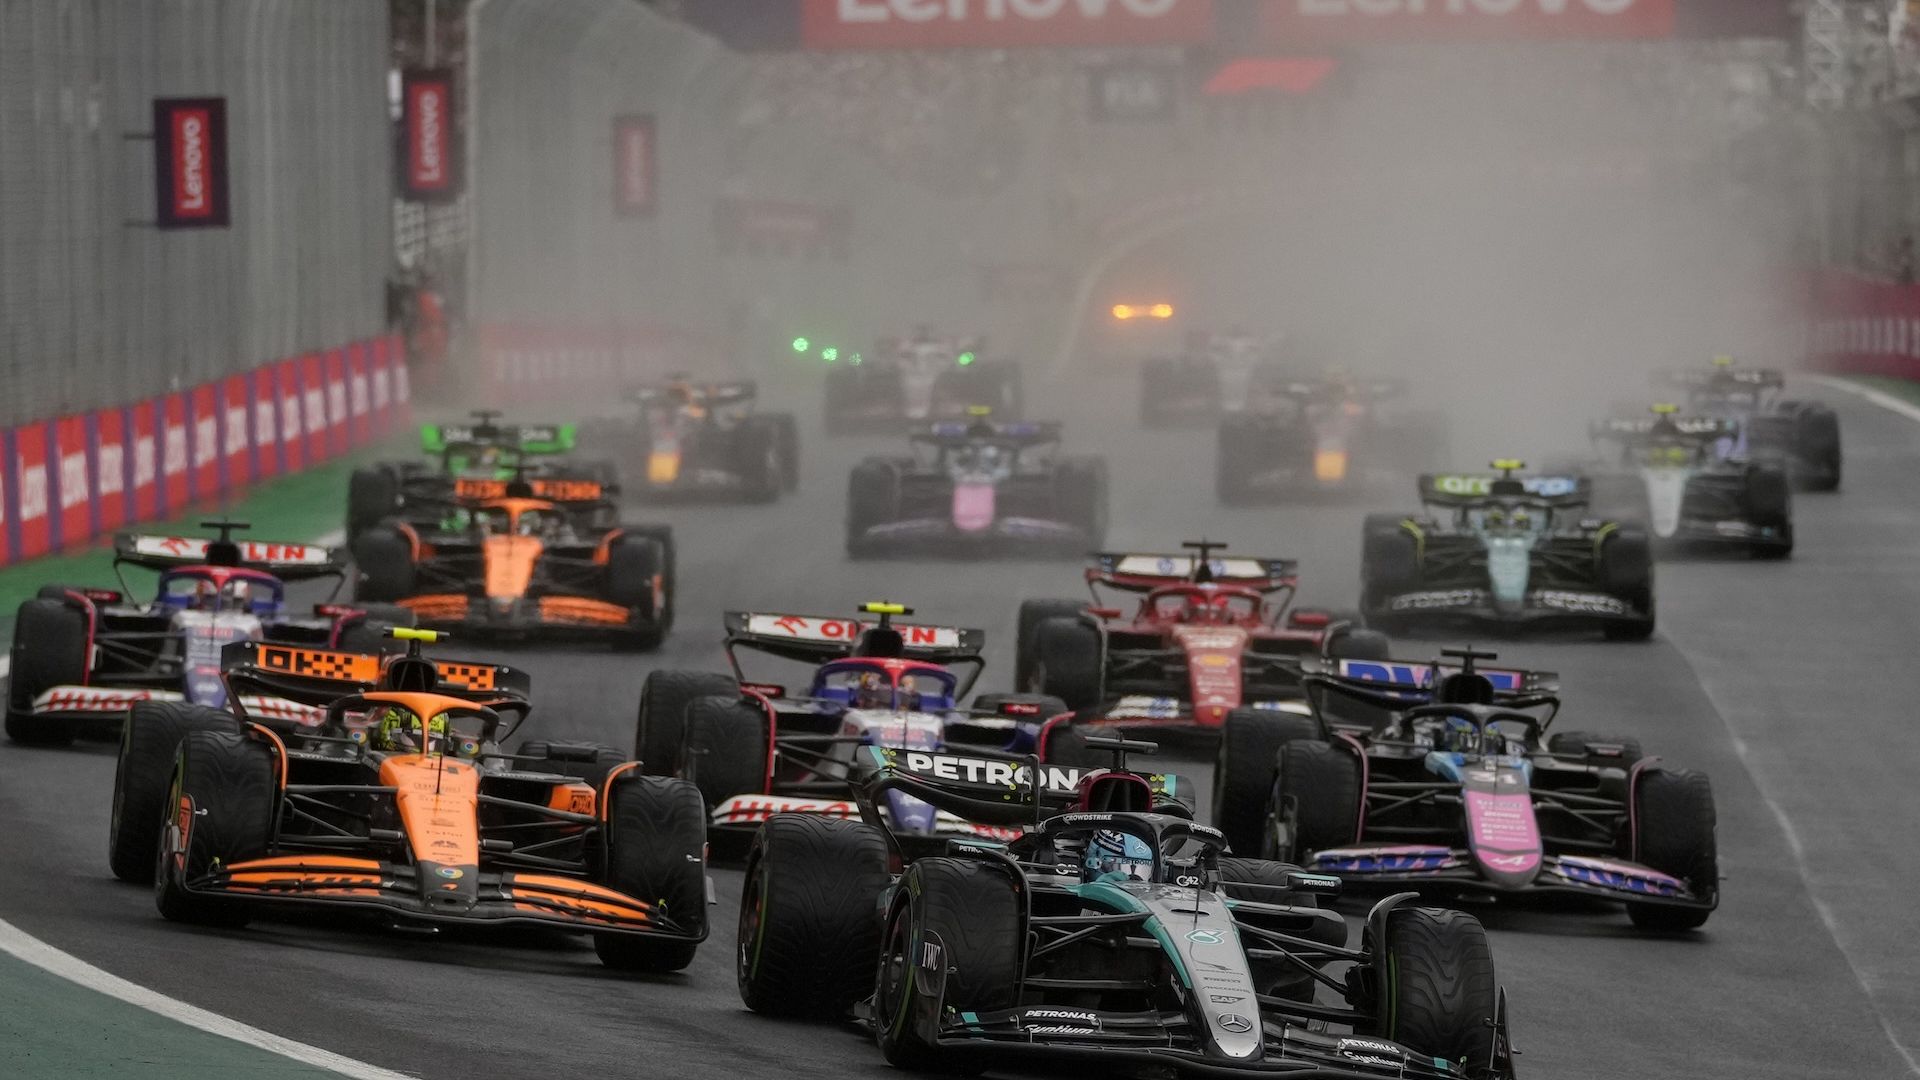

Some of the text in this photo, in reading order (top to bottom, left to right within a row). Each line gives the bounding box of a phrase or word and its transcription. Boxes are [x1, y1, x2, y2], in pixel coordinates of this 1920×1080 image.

[416, 90, 441, 182] Lenovo
[181, 116, 204, 210] Lenovo
[906, 753, 1080, 791] PETRON
[1176, 875, 1199, 887] G42
[1303, 879, 1335, 888] PETRONAS
[921, 941, 941, 971] IWC
[1024, 1010, 1097, 1020] PETRONAS
[1341, 1038, 1400, 1054] PETRONAS
